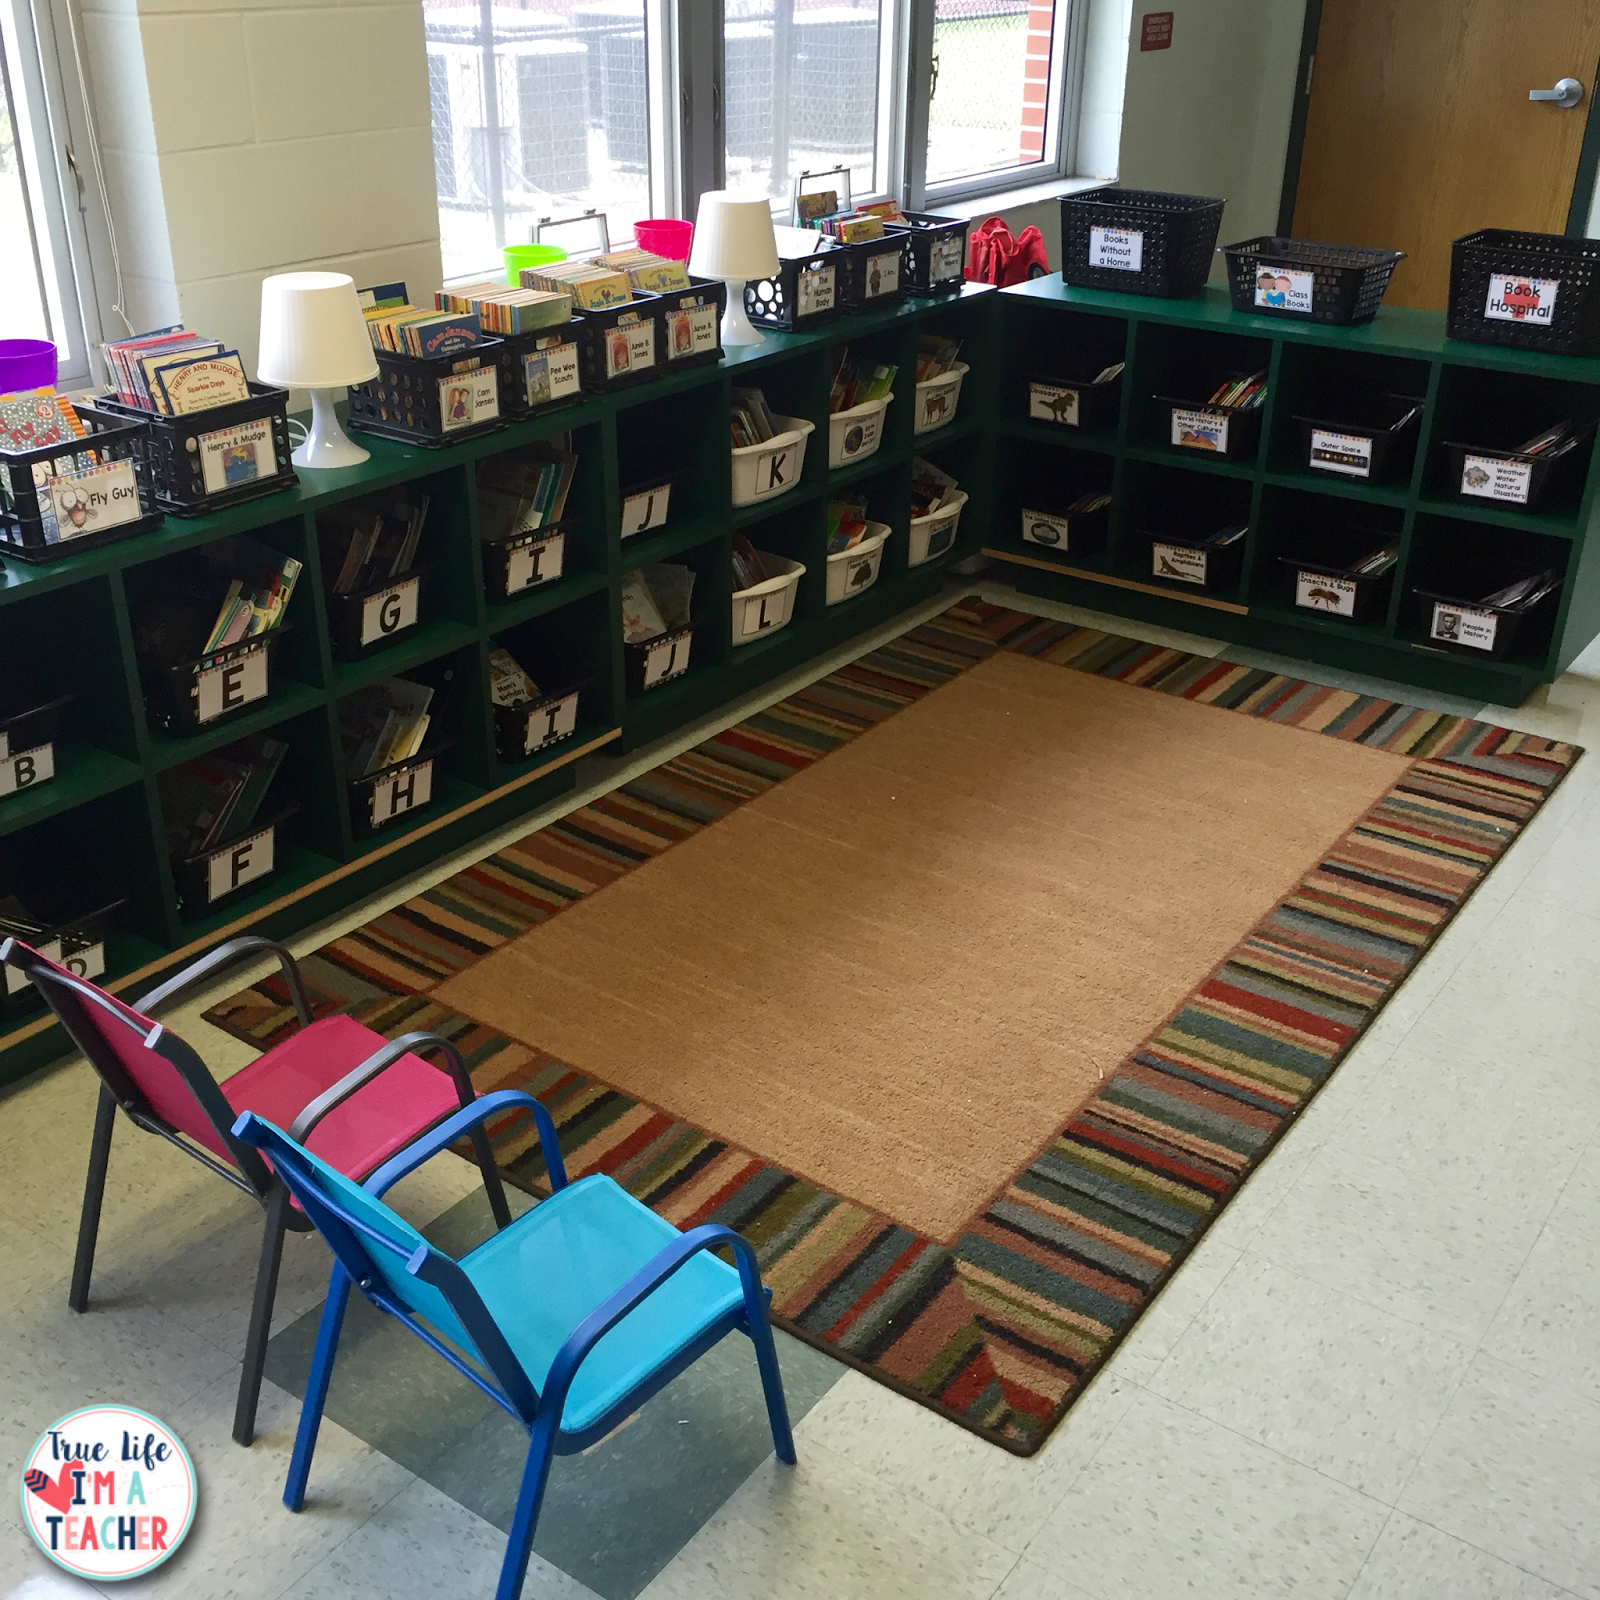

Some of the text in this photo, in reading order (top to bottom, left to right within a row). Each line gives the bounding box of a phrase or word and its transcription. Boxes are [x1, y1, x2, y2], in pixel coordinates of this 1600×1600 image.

[1104, 234, 1128, 244] Books
[1100, 245, 1131, 256] Without
[1099, 257, 1131, 267] a Home
[818, 276, 828, 285] The
[814, 287, 833, 297] Human
[1289, 290, 1308, 299] Class
[1504, 282, 1541, 298] Book
[816, 298, 830, 308] Body
[1286, 300, 1310, 309] Books
[1490, 299, 1551, 318] Hospital
[693, 323, 706, 333] Junie
[427, 326, 477, 352] Cam Jansen
[696, 332, 711, 342] Jones
[631, 341, 644, 351] Junie
[633, 350, 648, 359] Jones
[550, 363, 576, 375] Pee Wee
[173, 363, 238, 391] HENRY AND MUDGE
[555, 373, 573, 384] Scouts
[187, 380, 225, 394] Sparkle Days
[477, 388, 491, 397] Cam
[1030, 387, 1061, 398] Dinosaurs
[475, 397, 495, 408] Jansen
[1195, 418, 1218, 426] History
[10, 422, 35, 444] FLY
[34, 426, 61, 447] GUY
[1197, 425, 1222, 433] Cultures
[207, 430, 266, 453] Henry & Mudge
[1320, 441, 1361, 453] Outer Space
[769, 452, 786, 489] K
[1497, 467, 1527, 477] Weather
[1496, 475, 1517, 483] Water
[1494, 482, 1521, 491] Natural
[90, 485, 135, 508] Fly Guy
[1494, 489, 1526, 499] Disasters
[637, 495, 656, 531] J
[1173, 551, 1196, 560] Reptiles
[526, 548, 545, 585] I
[1171, 557, 1204, 568] Amphibians
[1300, 576, 1327, 587] Insects
[1337, 583, 1354, 593] Bugs
[380, 594, 401, 633] G
[758, 599, 771, 631] L
[1462, 622, 1485, 632] People
[1463, 630, 1488, 641] History
[660, 644, 677, 678] J
[222, 664, 244, 710] E
[542, 705, 562, 742] I
[14, 756, 36, 788] B
[391, 773, 415, 815] H
[231, 844, 252, 888] F
